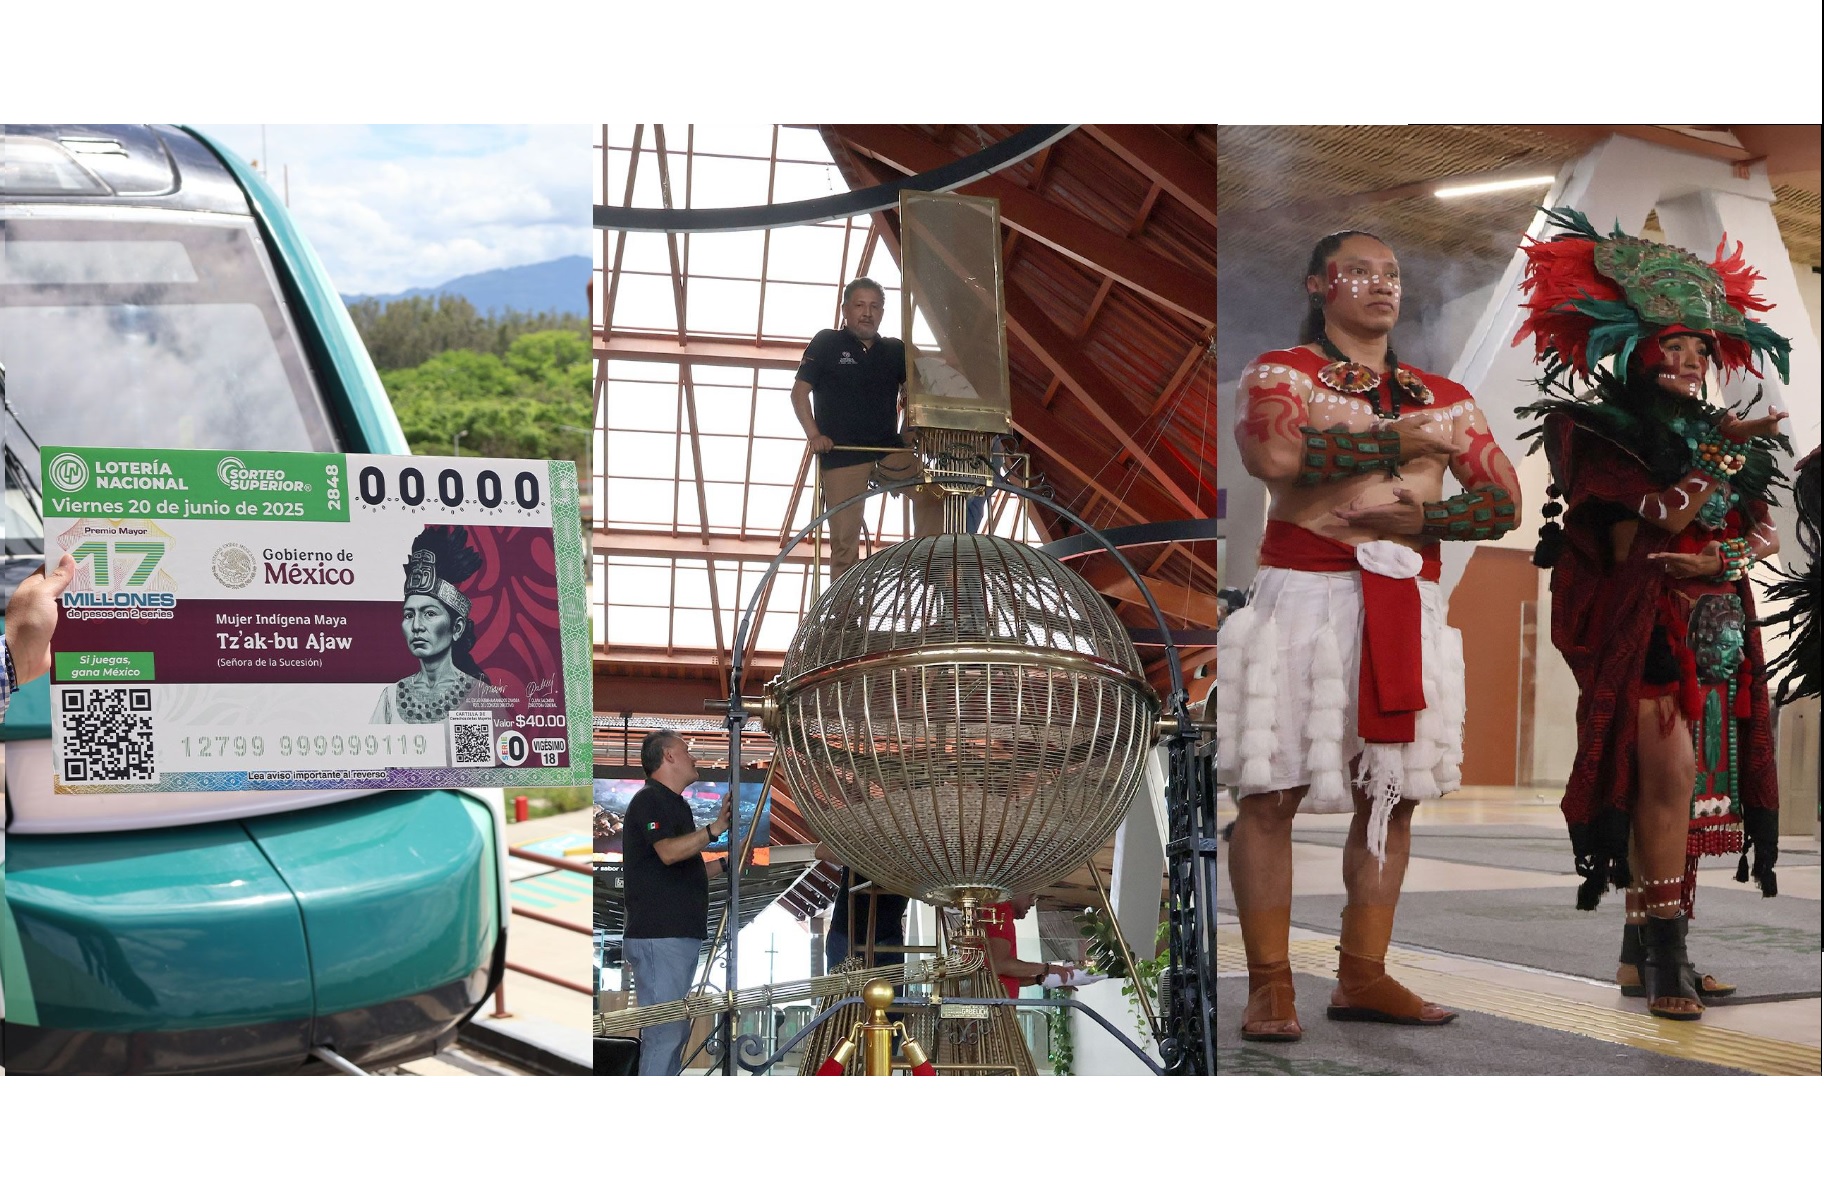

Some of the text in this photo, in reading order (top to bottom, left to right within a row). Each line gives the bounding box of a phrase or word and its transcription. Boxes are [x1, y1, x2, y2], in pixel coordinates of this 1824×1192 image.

[95, 459, 173, 475] LOTERÍA
[229, 469, 286, 481] SORTEO
[96, 476, 189, 490] NACIONAL
[325, 464, 342, 511] 2848
[51, 497, 305, 518] Viernes 20 de junio de 2025
[84, 526, 148, 537] Premio Mayor
[262, 548, 333, 561] Gobierno
[337, 548, 353, 561] de
[73, 541, 166, 587] 17
[264, 562, 355, 585] México
[64, 592, 175, 608] MILLONES
[67, 609, 173, 621] de pesos en 2 series
[216, 613, 347, 627] Mujer Indígena Maya
[305, 632, 353, 653] Ajaw
[79, 655, 132, 667] Si juegas,
[217, 657, 323, 668] (Señora de la Sucesión)
[71, 666, 141, 679] gana México
[494, 714, 566, 728] Valor $40.00
[500, 736, 509, 760] SERIE
[509, 735, 525, 761] 0
[533, 738, 565, 752] VIGÉSIMO
[543, 753, 556, 764] 18
[248, 770, 386, 782] Lea aviso importante al reverso
